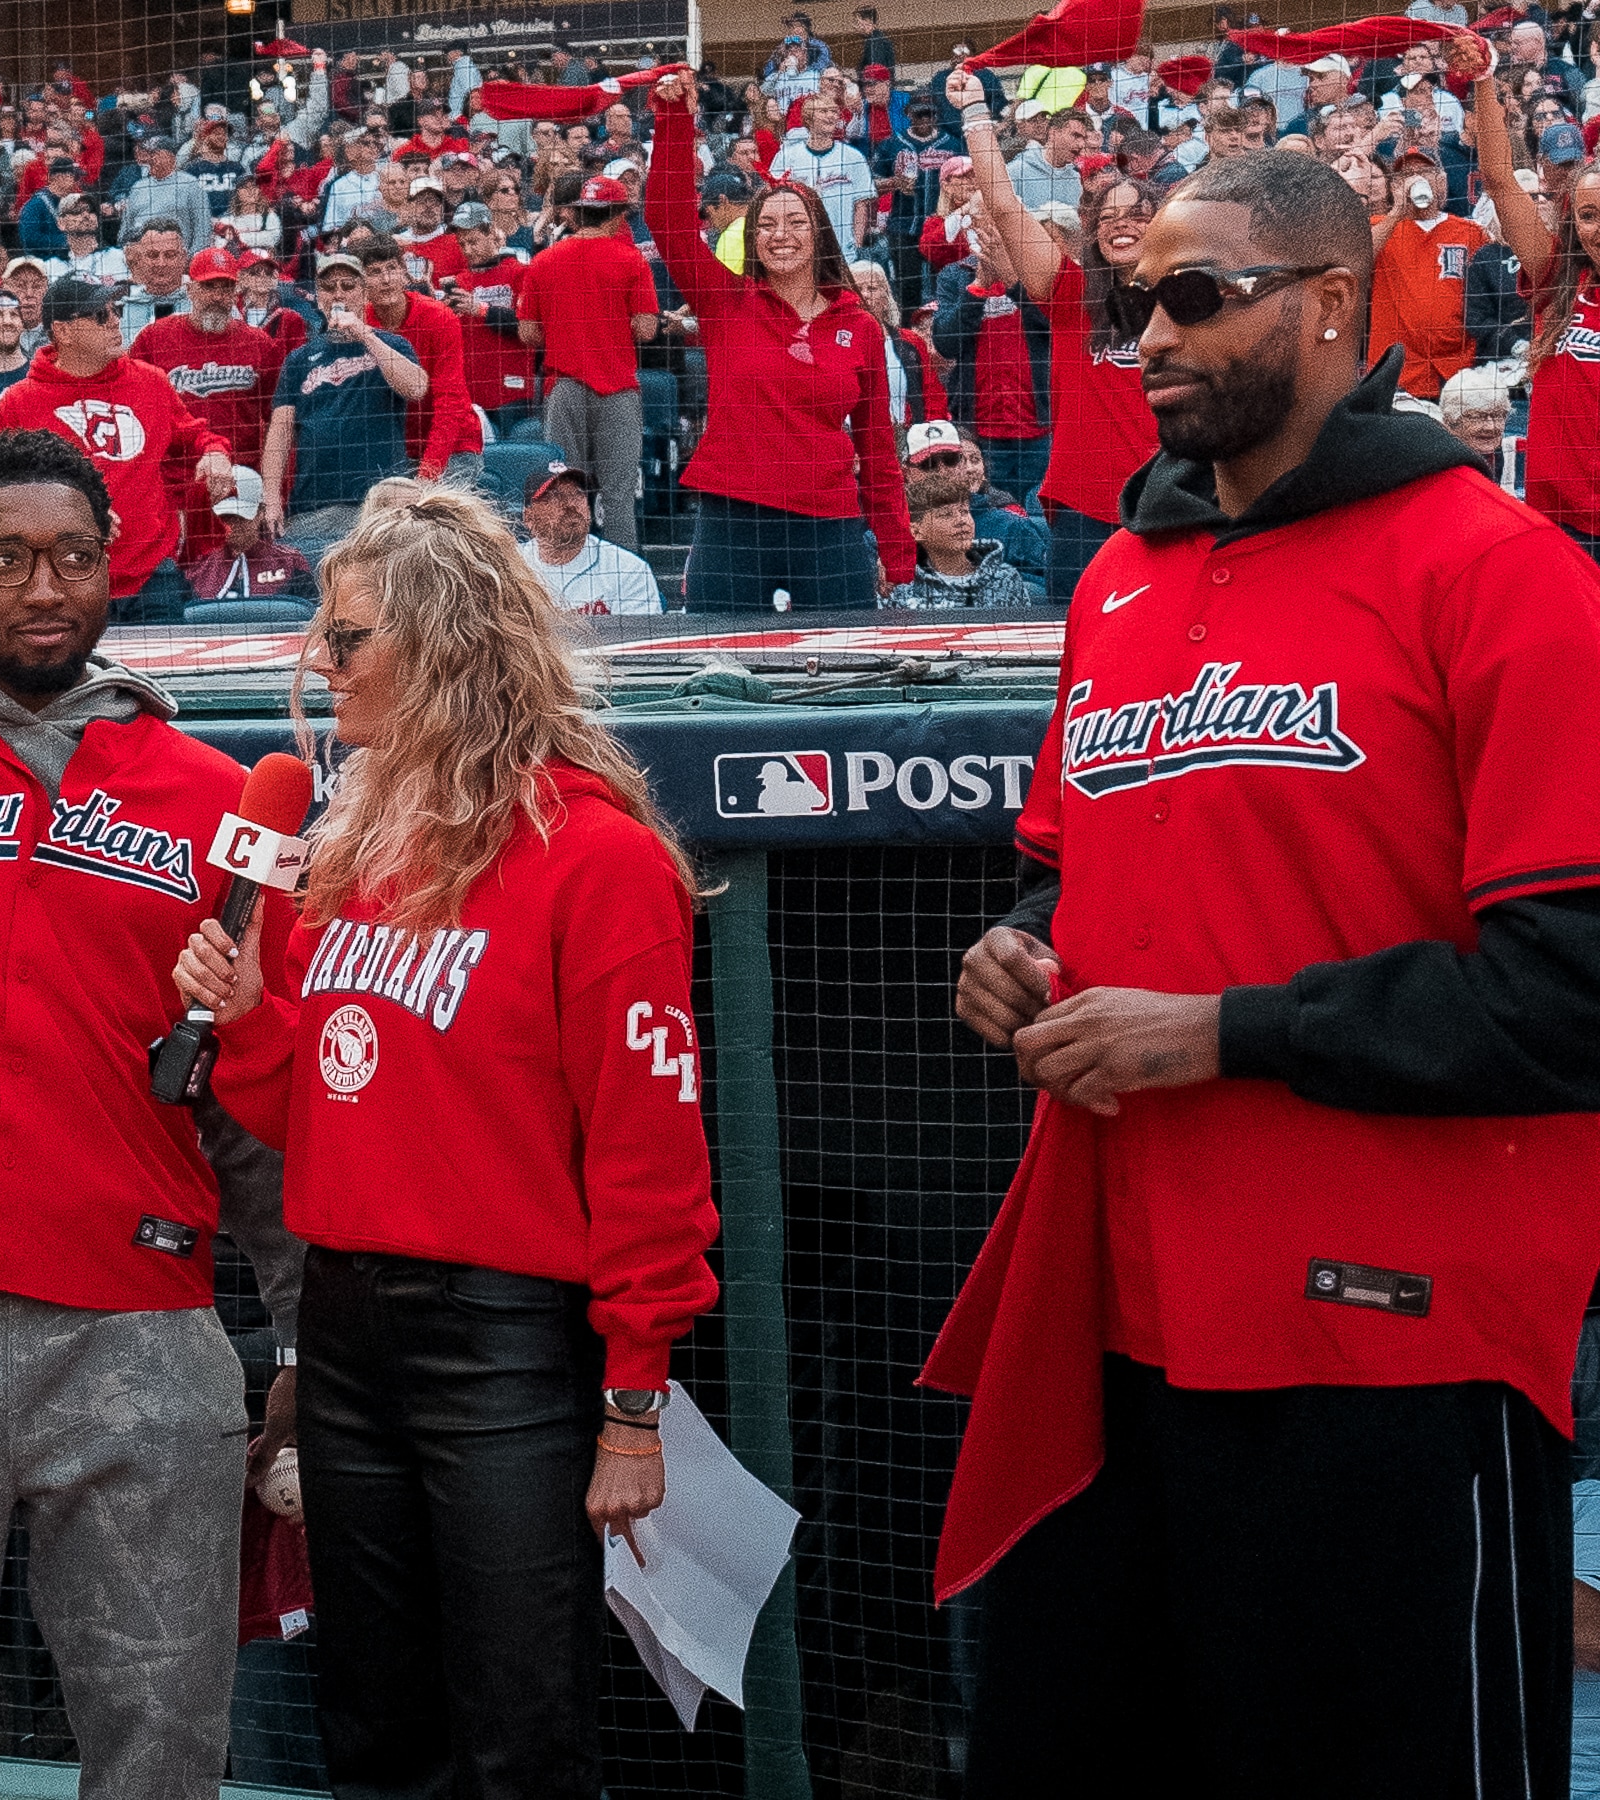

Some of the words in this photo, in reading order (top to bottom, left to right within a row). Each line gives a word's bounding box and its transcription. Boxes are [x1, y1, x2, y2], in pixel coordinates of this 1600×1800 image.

[225, 826, 262, 869] C
[326, 1011, 374, 1044] CLEVELAND
[323, 1056, 374, 1086] GUARDIANS
